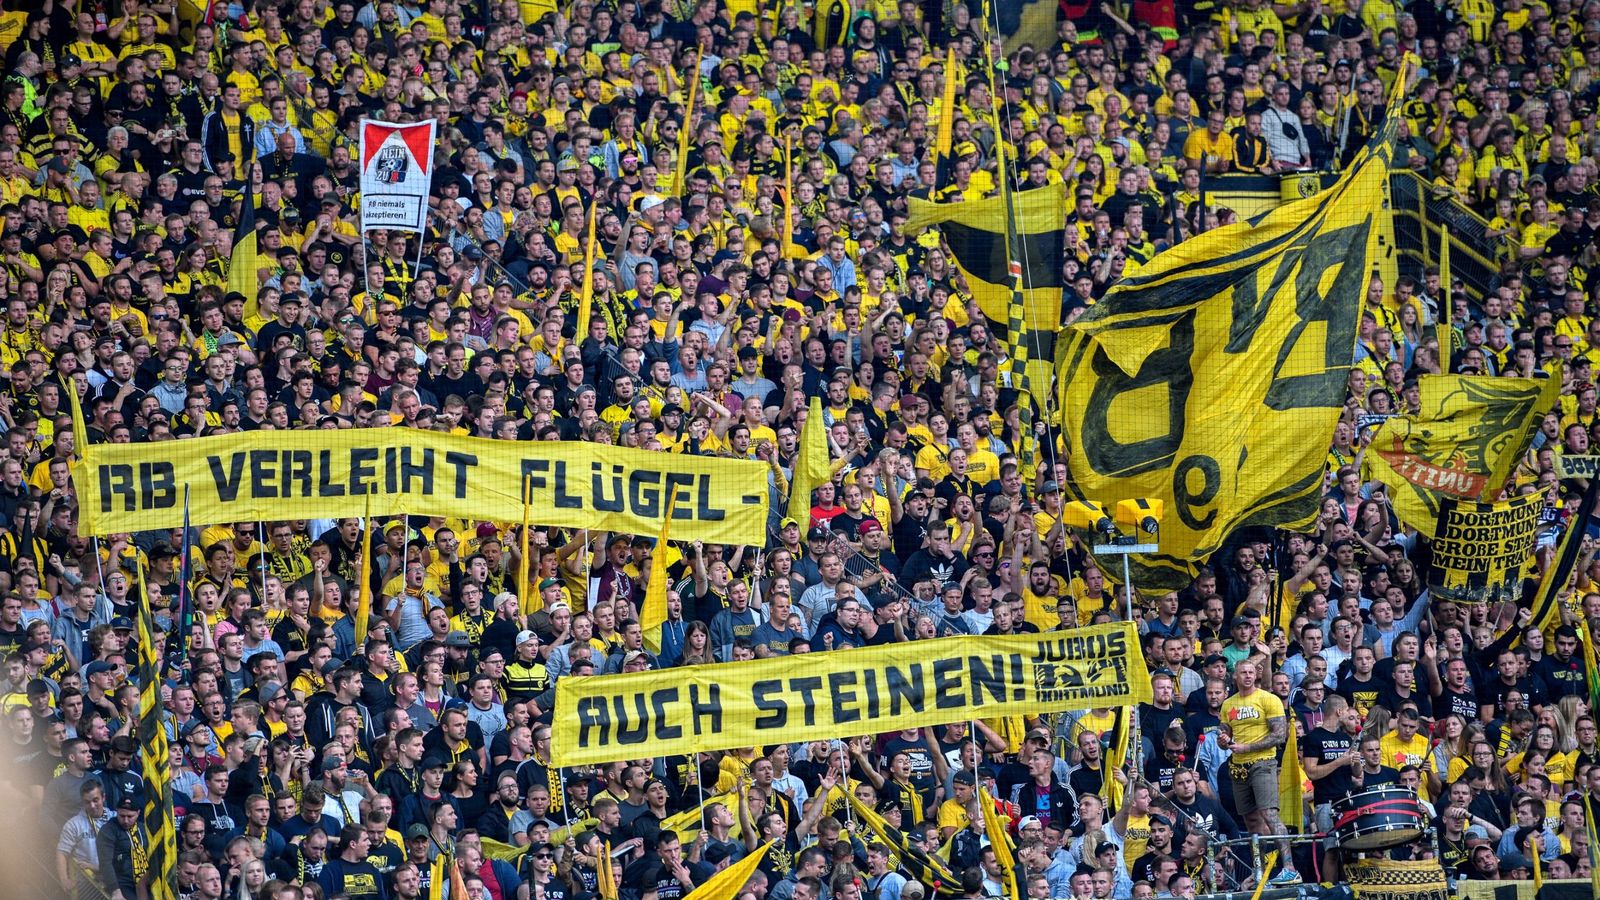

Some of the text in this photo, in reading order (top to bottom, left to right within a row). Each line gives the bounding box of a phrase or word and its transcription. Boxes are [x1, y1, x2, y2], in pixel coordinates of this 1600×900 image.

[381, 147, 406, 159] NEIN
[378, 200, 405, 208] niemals
[365, 211, 407, 220] akzeptieren!
[98, 461, 177, 513] RB
[207, 446, 479, 502] VERLEIHT
[521, 459, 726, 521] FLÜGEL
[1447, 517, 1537, 541] DORTMUN
[1503, 534, 1534, 553] STA
[1433, 554, 1489, 573] MEIN
[1032, 631, 1128, 663] JUBOS
[577, 653, 1026, 748] AUCH STEINEN!
[1036, 682, 1130, 702] DORTMUND
